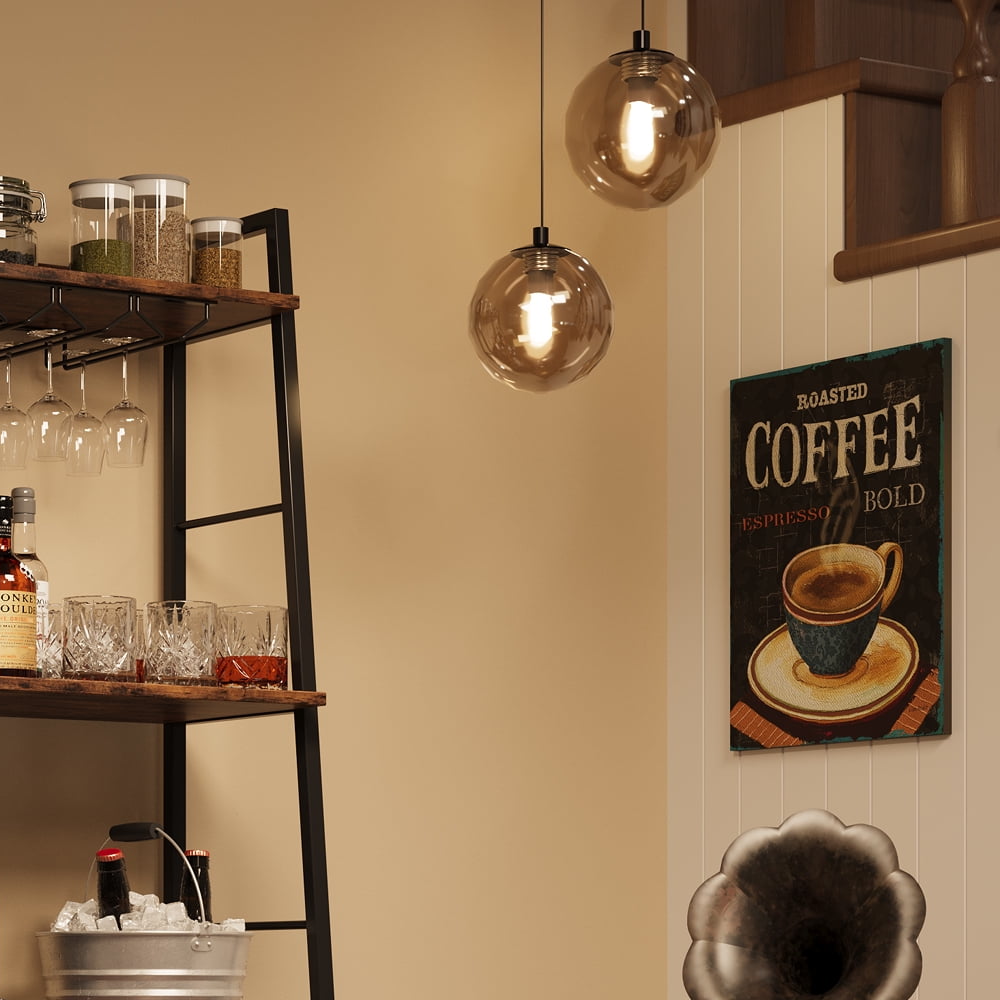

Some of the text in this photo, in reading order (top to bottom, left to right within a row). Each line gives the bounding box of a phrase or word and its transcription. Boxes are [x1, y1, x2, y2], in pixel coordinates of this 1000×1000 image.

[797, 382, 869, 411] ROASTED
[745, 394, 922, 491] COFFEE
[864, 483, 926, 513] BOLD
[742, 505, 831, 532] ESPRESSO
